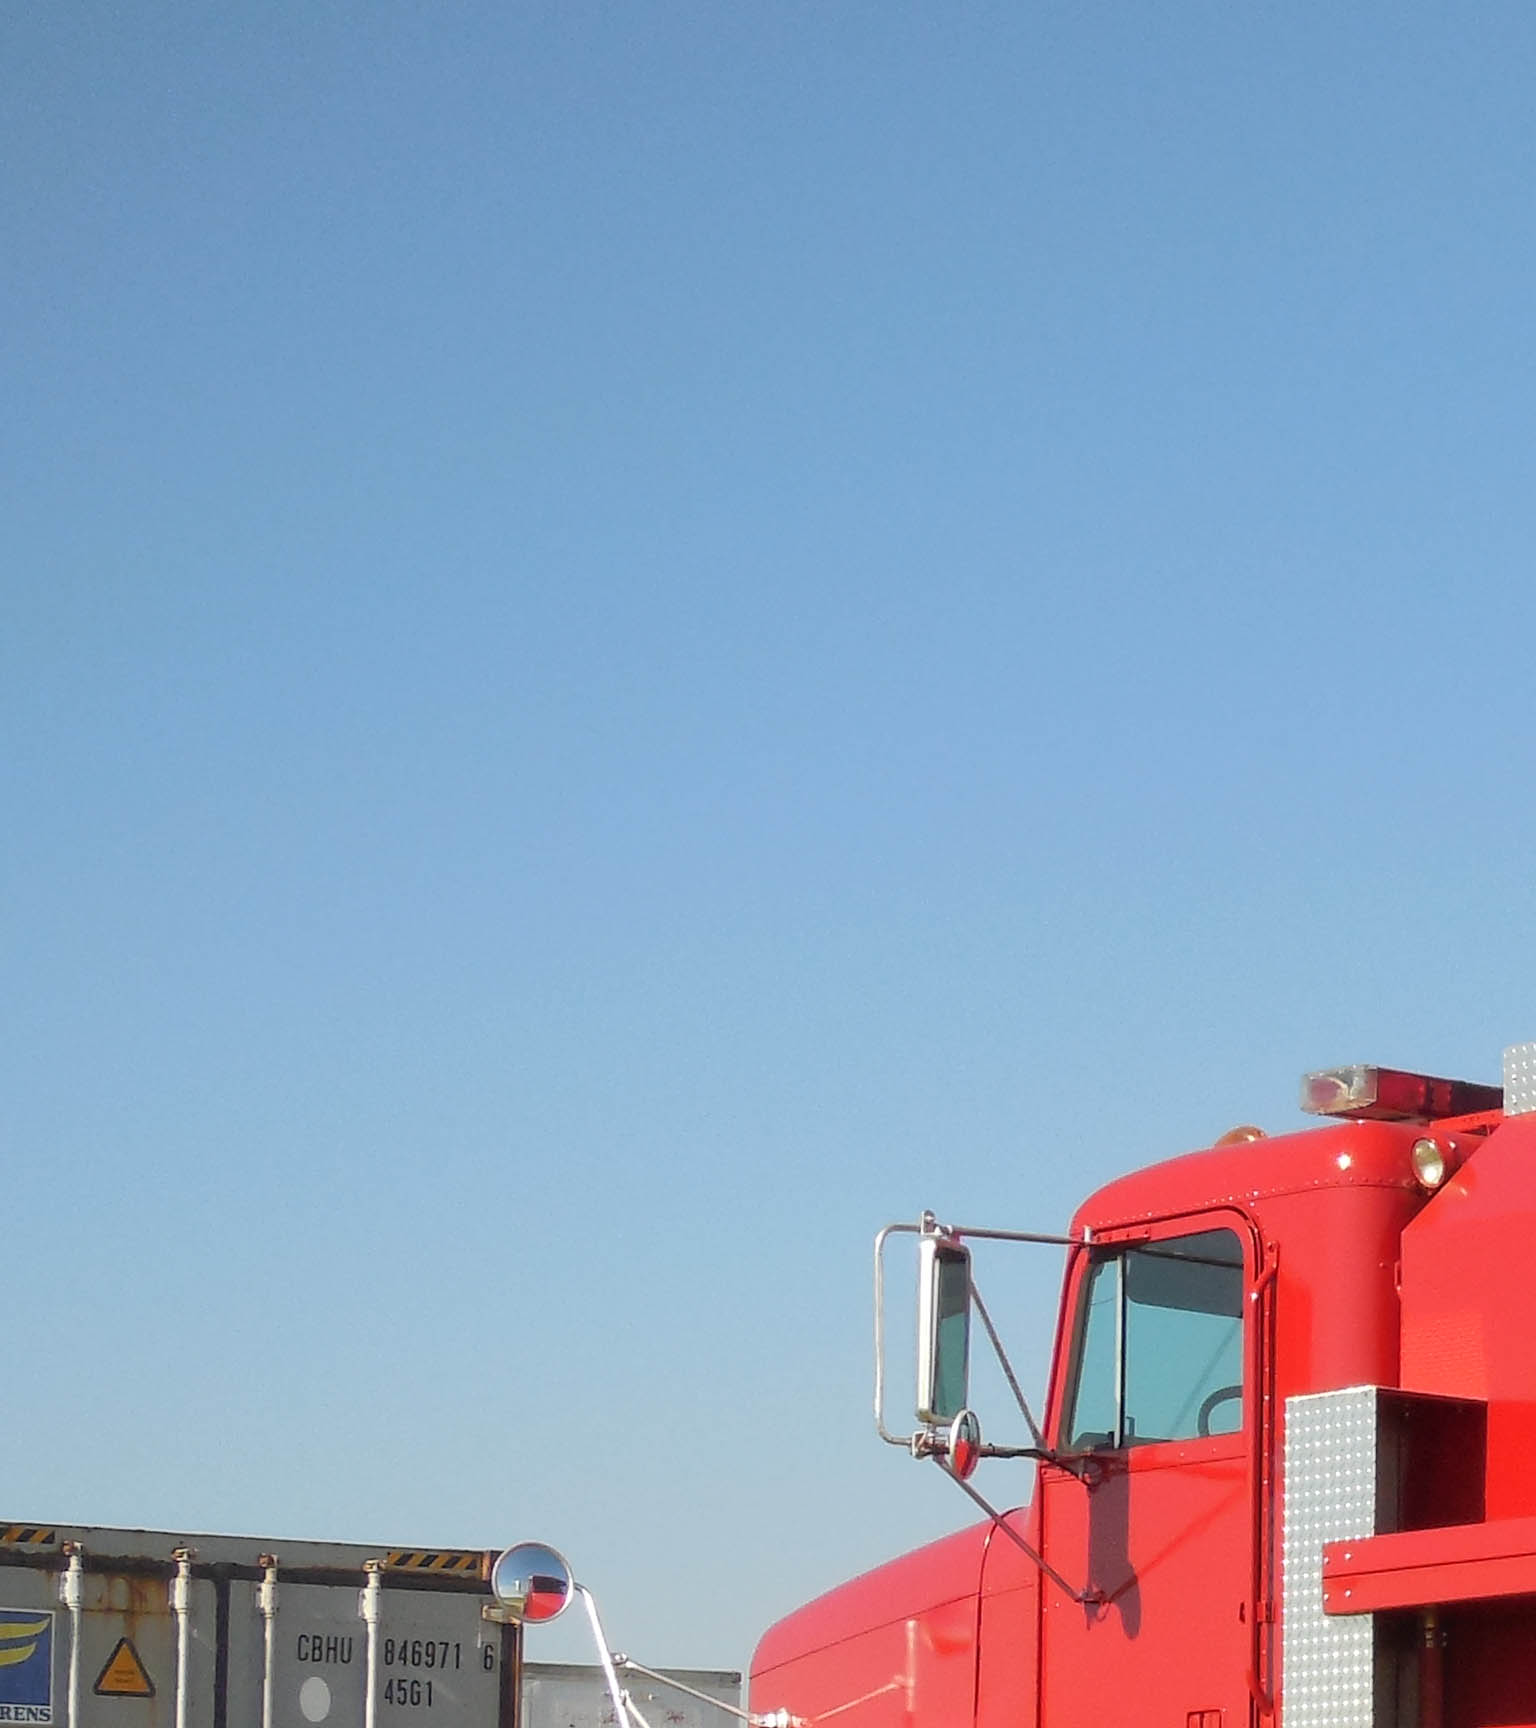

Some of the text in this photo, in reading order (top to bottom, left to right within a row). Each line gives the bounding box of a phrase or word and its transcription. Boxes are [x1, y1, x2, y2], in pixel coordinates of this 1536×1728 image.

[297, 1634, 494, 1670] CBHU 846971 6
[384, 1679, 433, 1707] 45G1
